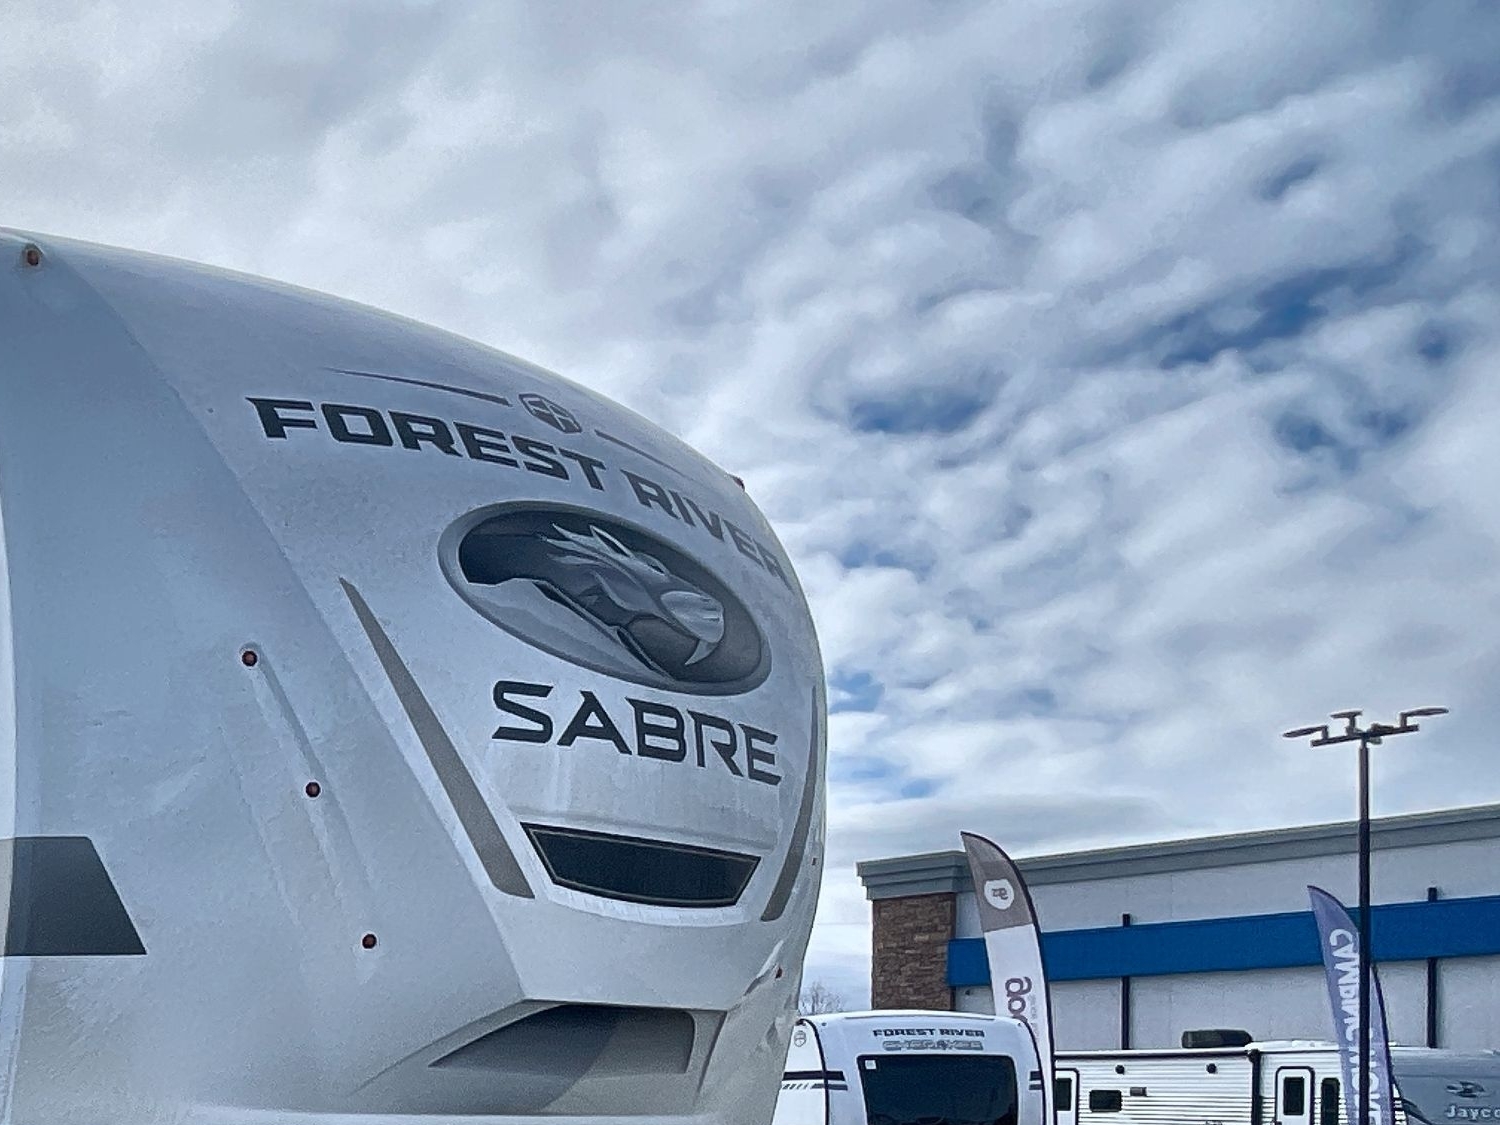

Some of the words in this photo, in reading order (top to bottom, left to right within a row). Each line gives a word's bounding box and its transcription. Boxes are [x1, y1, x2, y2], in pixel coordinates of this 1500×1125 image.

[245, 397, 606, 492] FOREST
[620, 468, 797, 597] RIVER
[491, 680, 782, 786] SABRE
[873, 1028, 936, 1037] FOREST
[938, 1028, 985, 1037] RIVER
